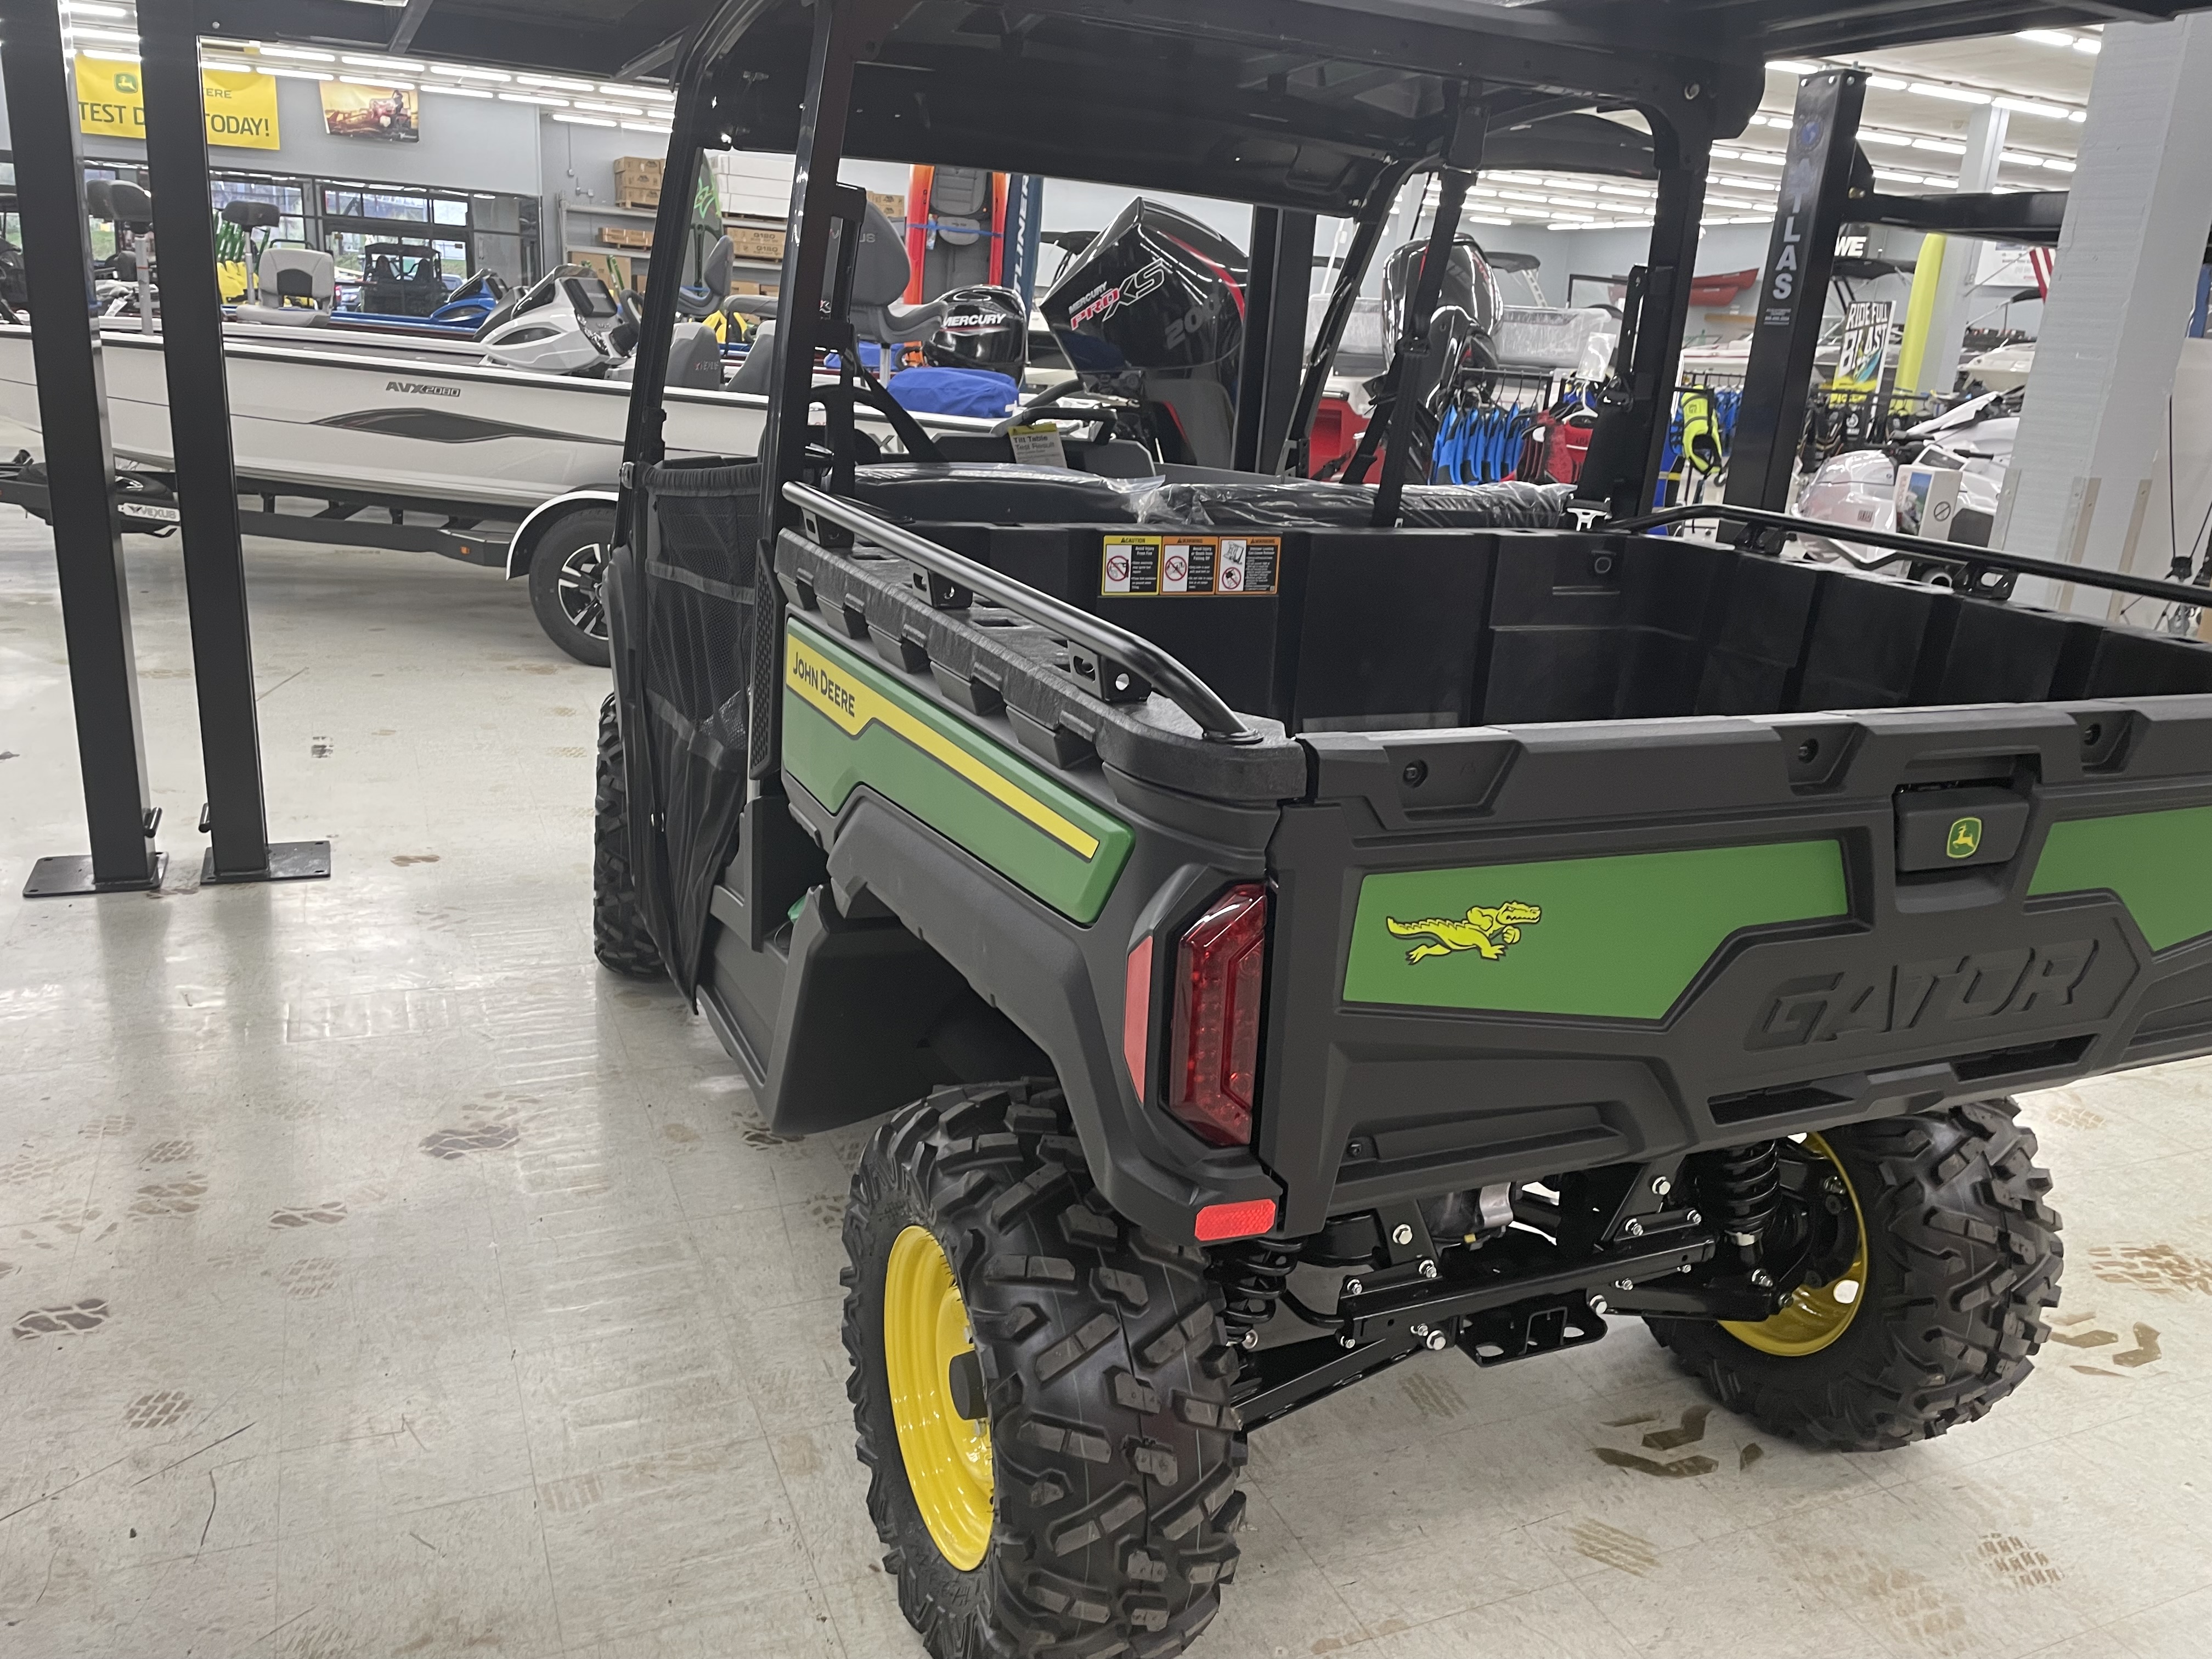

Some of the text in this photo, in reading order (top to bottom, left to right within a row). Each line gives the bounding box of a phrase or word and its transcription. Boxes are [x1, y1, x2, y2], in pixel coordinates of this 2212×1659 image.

[78, 101, 126, 124] TEST
[203, 87, 232, 99] ERE
[1773, 157, 1815, 300] ATLAS
[1069, 281, 1107, 314] MERCURY
[1070, 257, 1165, 330] PRO XS
[943, 313, 1006, 327] MERCURY
[1164, 293, 1222, 349] 200
[1846, 302, 1888, 330] RIDE FULL
[793, 651, 855, 718] JOHN DEERE
[1740, 938, 2100, 1051] GATOR
